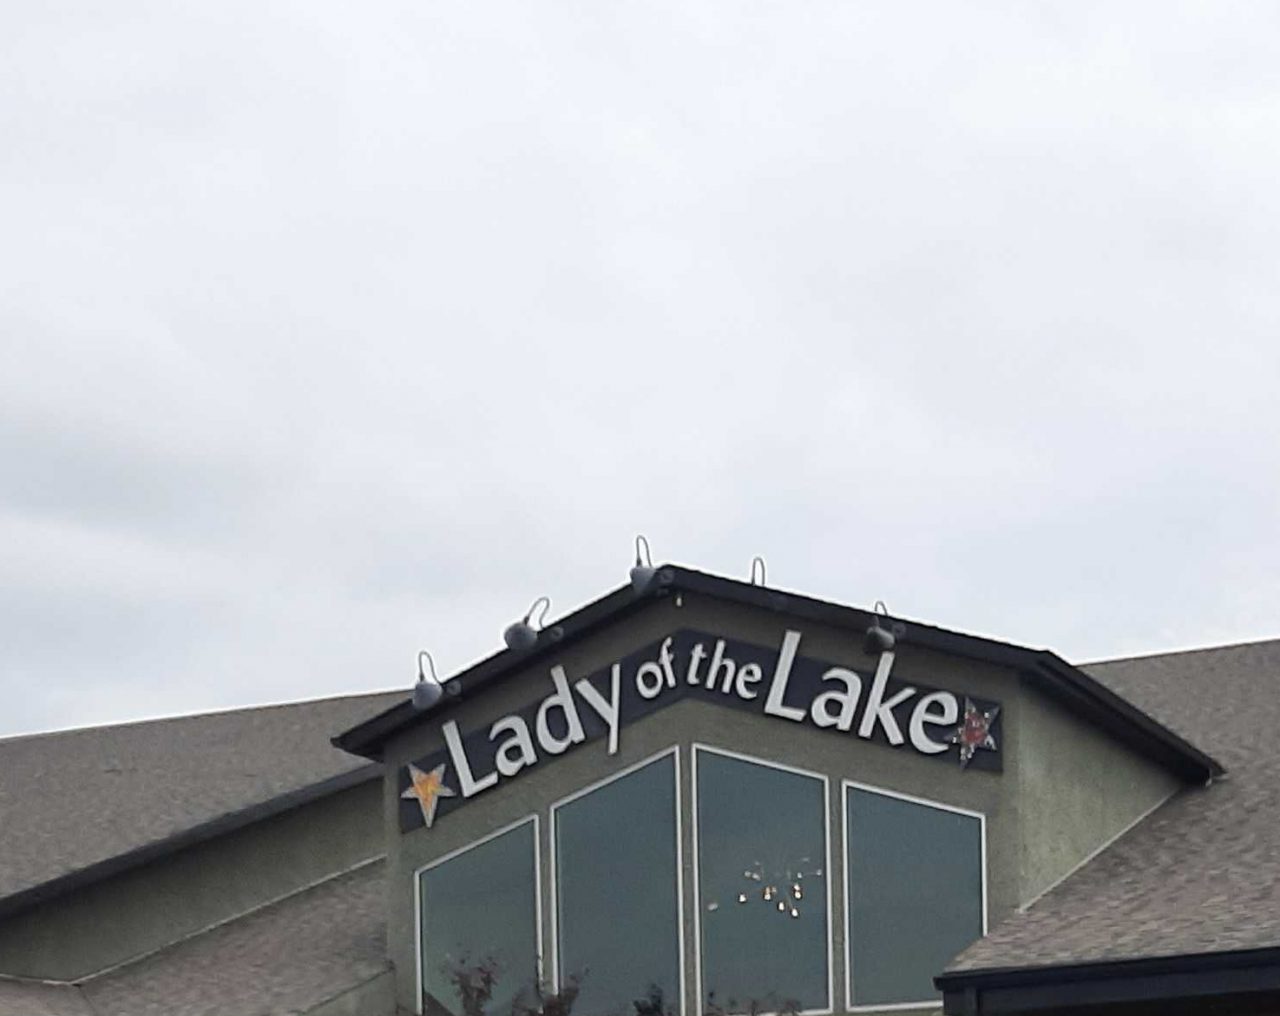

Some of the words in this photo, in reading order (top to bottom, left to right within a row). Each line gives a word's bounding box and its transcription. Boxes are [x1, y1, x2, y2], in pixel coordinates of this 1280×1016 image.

[442, 663, 621, 798] Lady
[636, 636, 678, 699] of
[687, 639, 763, 700] the
[765, 630, 960, 756] Lake
